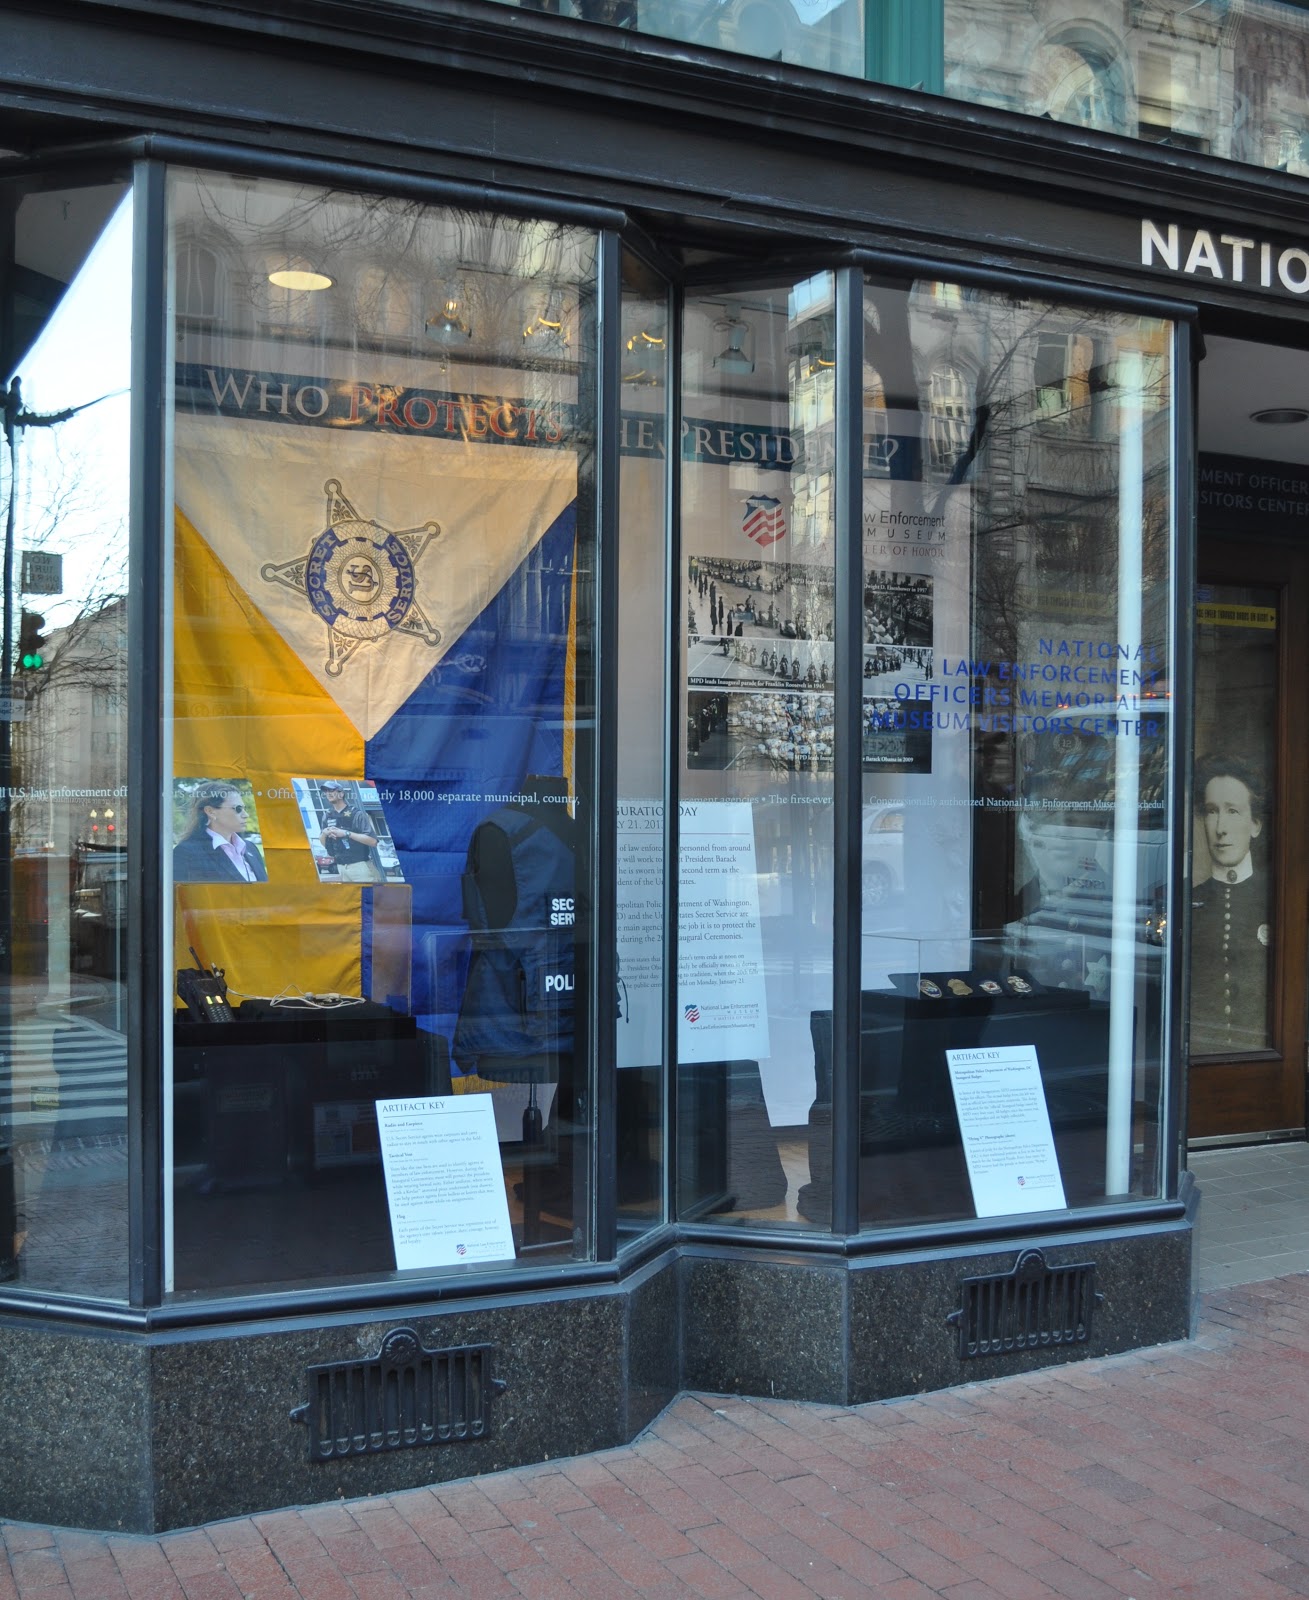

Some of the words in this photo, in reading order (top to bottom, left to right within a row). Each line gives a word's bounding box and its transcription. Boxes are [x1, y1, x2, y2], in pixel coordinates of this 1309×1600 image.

[1141, 218, 1309, 294] NATIO
[205, 368, 329, 418] WHO
[348, 383, 563, 444] PROTECTS
[879, 509, 946, 529] Enforcement
[310, 534, 337, 618] SECRET
[386, 541, 413, 623] SERVICE
[1038, 638, 1159, 664] NATIONAL
[943, 658, 991, 679] LAW
[999, 662, 1159, 688] ENFORCEMENT
[893, 682, 1011, 707] OFFICERS
[1019, 690, 1140, 712] MEMORIAL
[871, 709, 970, 731] MUSEUM
[977, 713, 1075, 735] VISITORS
[1079, 717, 1159, 738] CENTER
[8, 787, 29, 798] U.S.
[31, 786, 48, 798] law
[49, 786, 112, 798] enforcement
[113, 785, 128, 798] off
[399, 790, 434, 803] 18,000
[437, 791, 482, 805] separate
[484, 791, 540, 806] municipal,
[542, 793, 580, 806] county,
[769, 794, 787, 804] The
[986, 796, 1022, 808] National
[1024, 798, 1041, 808] Law
[1042, 798, 1095, 809] Enforcement
[619, 843, 628, 852] of
[628, 844, 639, 852] law
[711, 844, 728, 852] from
[728, 844, 751, 852] around
[623, 855, 636, 863] will
[637, 855, 654, 863] work
[685, 855, 714, 863] President
[716, 855, 737, 863] Barack
[681, 866, 704, 874] second
[729, 866, 740, 874] the
[642, 877, 654, 886] the
[551, 898, 575, 912] SEC
[704, 899, 712, 908] of
[628, 912, 641, 920] and
[642, 912, 653, 920] the
[695, 910, 715, 919] Secret
[715, 910, 738, 919] Service
[623, 923, 640, 932] main
[688, 922, 699, 932] job
[722, 922, 745, 931] protect
[745, 921, 756, 929] the
[620, 935, 643, 945] during
[644, 935, 655, 943] the
[952, 1052, 986, 1062] ARTIFACT
[987, 1051, 1001, 1060] KEY
[382, 1102, 427, 1113] ARTIFACT
[428, 1100, 446, 1110] KEY
